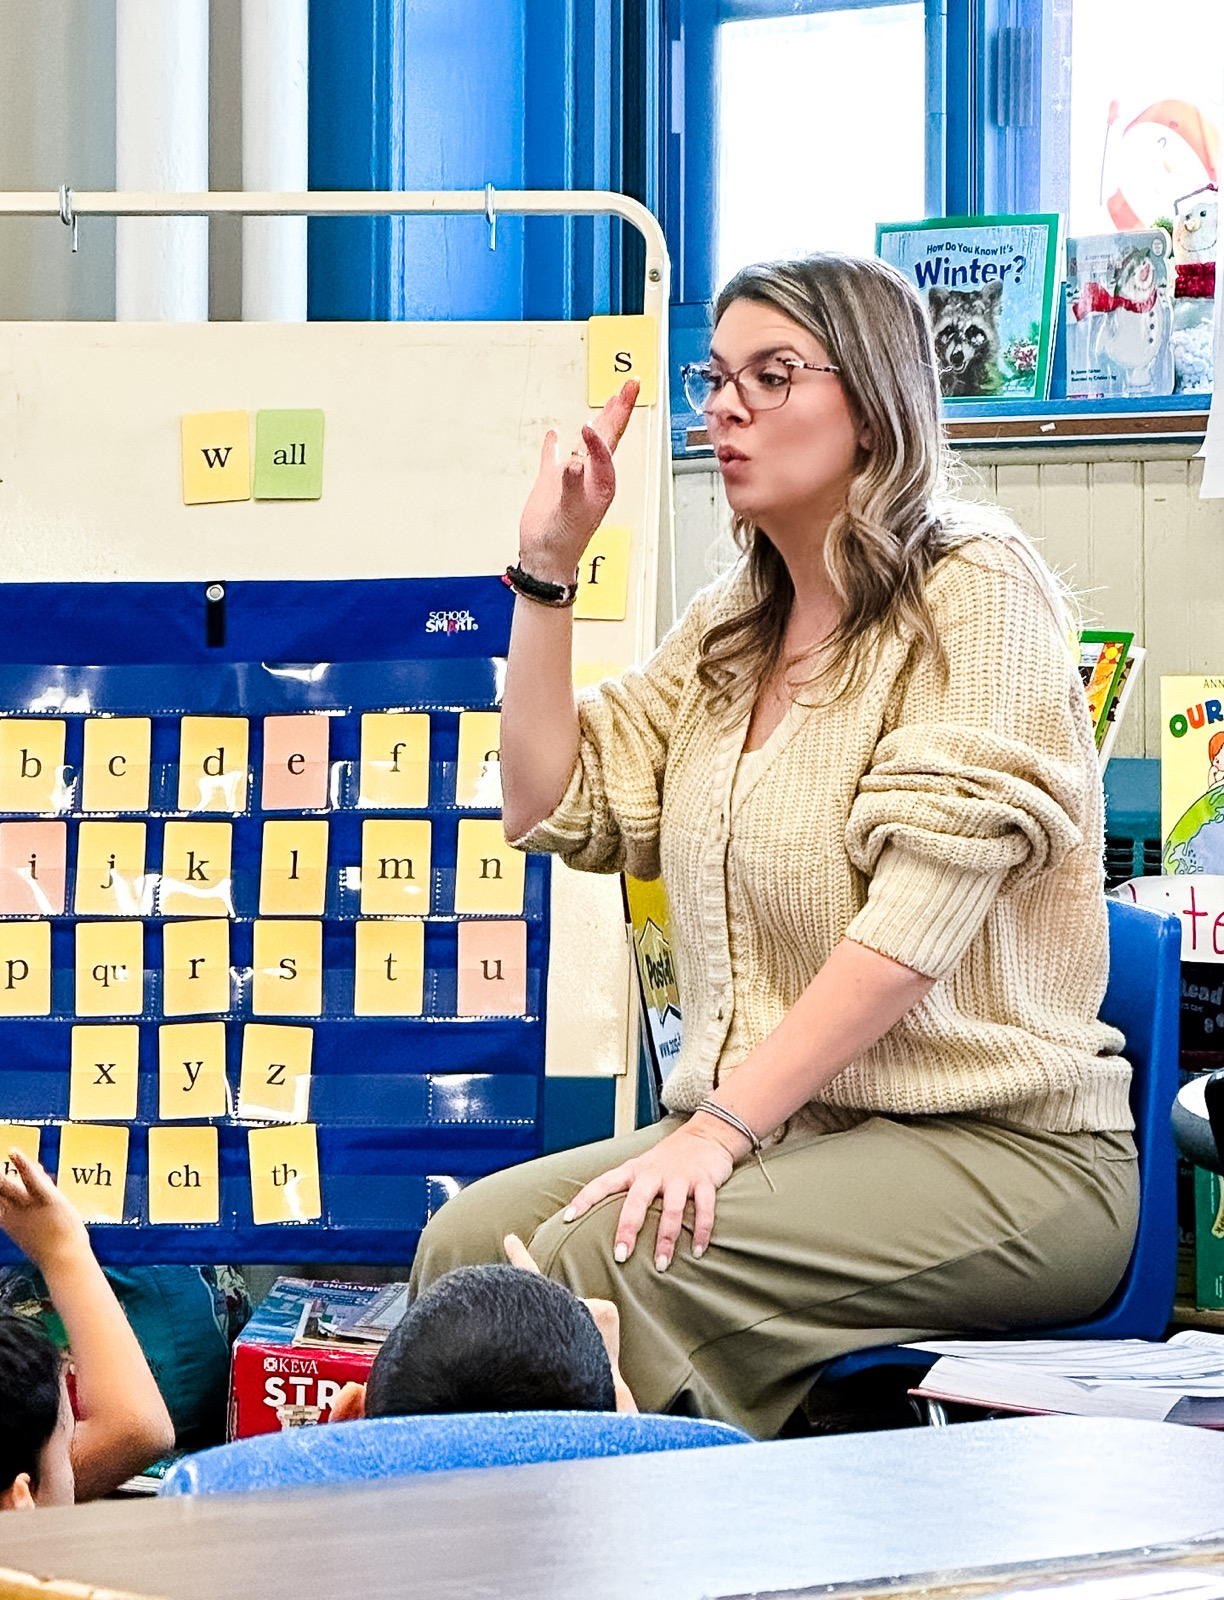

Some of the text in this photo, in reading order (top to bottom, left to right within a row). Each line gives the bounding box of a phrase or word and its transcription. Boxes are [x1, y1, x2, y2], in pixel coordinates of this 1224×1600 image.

[926, 241, 1014, 256] How Do You Know It's
[914, 255, 1027, 288] Winter?
[614, 352, 632, 373] s
[201, 443, 306, 469] w all
[587, 555, 606, 585] f
[425, 617, 475, 637] SMART
[428, 609, 470, 621] SCHOOL
[1169, 699, 1224, 738] OUR
[20, 742, 407, 778] b c d e f
[28, 850, 503, 889] i j k l m n
[4, 953, 505, 990] p qu r s t u
[93, 1060, 286, 1092] x y z
[71, 1162, 112, 1187] wh
[167, 1164, 201, 1188] ch
[271, 1163, 298, 1187] th
[278, 1357, 319, 1375] KEVA
